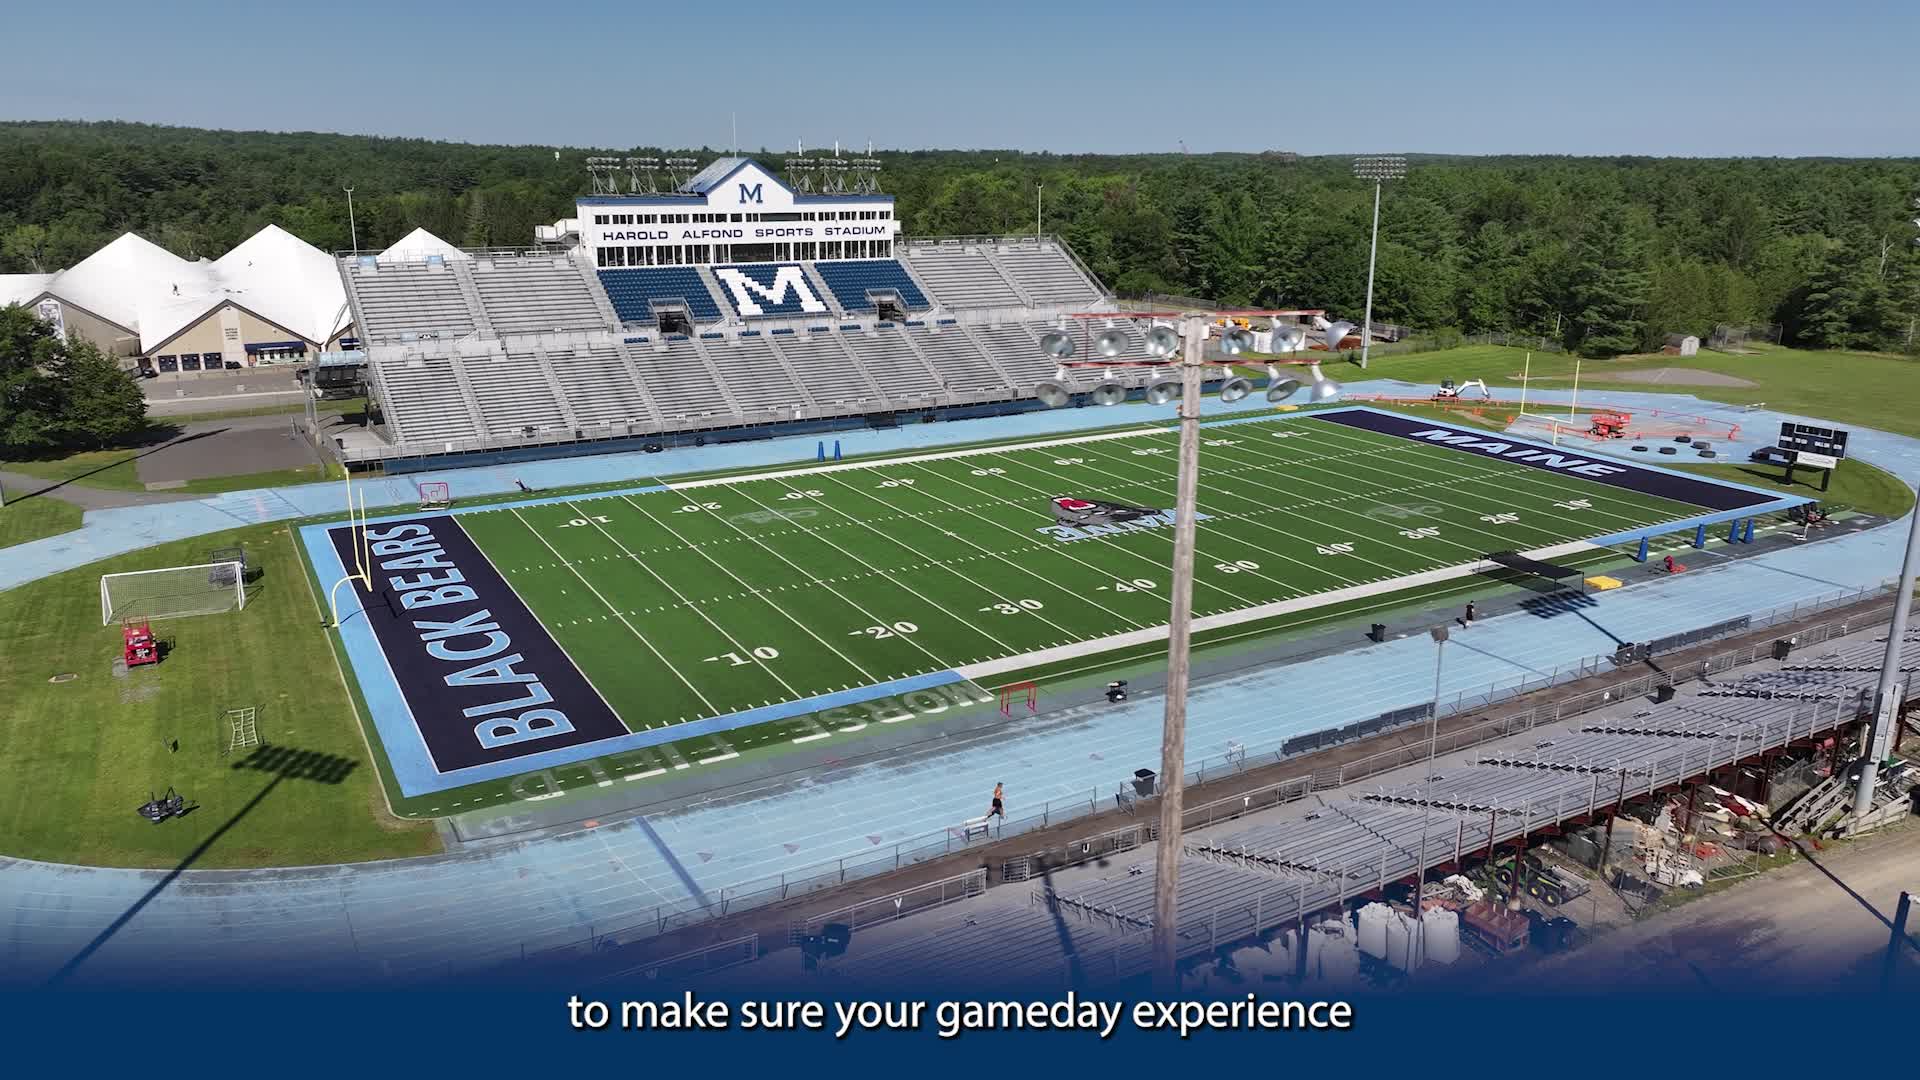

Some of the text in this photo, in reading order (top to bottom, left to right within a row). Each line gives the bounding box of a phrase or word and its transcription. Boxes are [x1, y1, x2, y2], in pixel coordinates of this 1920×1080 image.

[739, 183, 763, 204] M
[602, 225, 886, 241] HAROLD ALFOND SPORTS STADIUM
[714, 265, 828, 317] M
[1131, 447, 1165, 457] 30
[1408, 428, 1628, 478] MAINE
[1053, 456, 1089, 467] 40
[970, 467, 1007, 478] 50
[882, 477, 917, 489] 40
[784, 488, 825, 501] 30
[681, 500, 723, 514] 20
[1553, 498, 1593, 511] 10
[568, 514, 615, 528] 10
[1480, 512, 1517, 526] 20
[1398, 526, 1440, 541] 30
[1314, 542, 1352, 557] 40
[1213, 559, 1261, 574] 50
[1114, 577, 1158, 594] 40
[989, 598, 1044, 616] 30
[362, 522, 577, 751] BLACK BEARS
[864, 620, 920, 641] 20
[718, 645, 780, 667] 10
[1082, 842, 1090, 854] U
[894, 896, 903, 908] V
